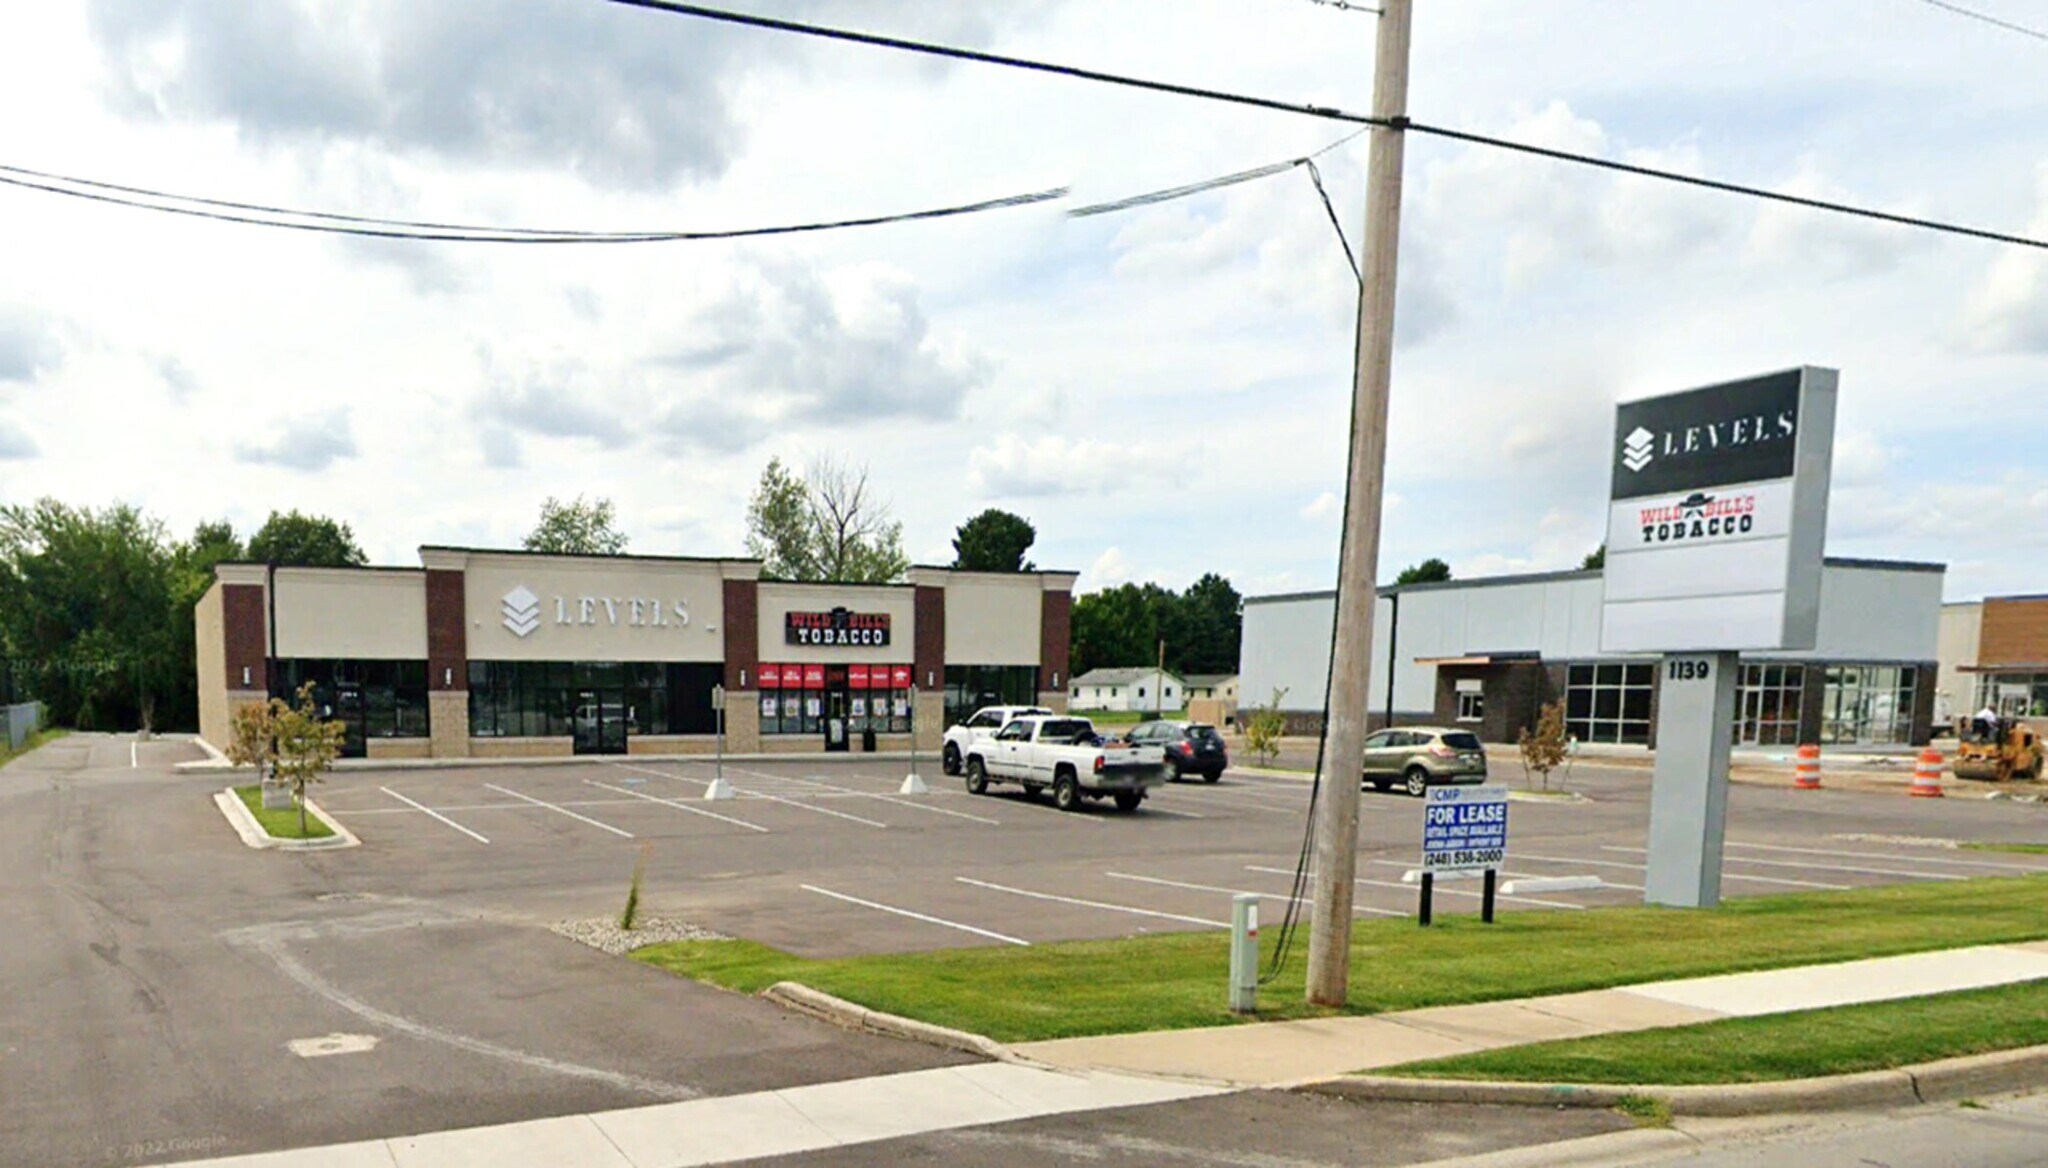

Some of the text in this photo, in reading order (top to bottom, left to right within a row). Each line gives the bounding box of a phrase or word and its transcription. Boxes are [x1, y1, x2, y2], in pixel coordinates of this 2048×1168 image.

[1663, 410, 1794, 456] LEVELS
[1640, 505, 1683, 525] WILD
[1643, 514, 1753, 543] TOBACCO
[553, 595, 691, 627] LEVELS
[790, 612, 832, 628] WILD
[798, 628, 883, 645] TOBACCO
[1669, 660, 1709, 680] 1139
[1435, 788, 1460, 801] CMP
[1427, 804, 1505, 826] FOR LEASE
